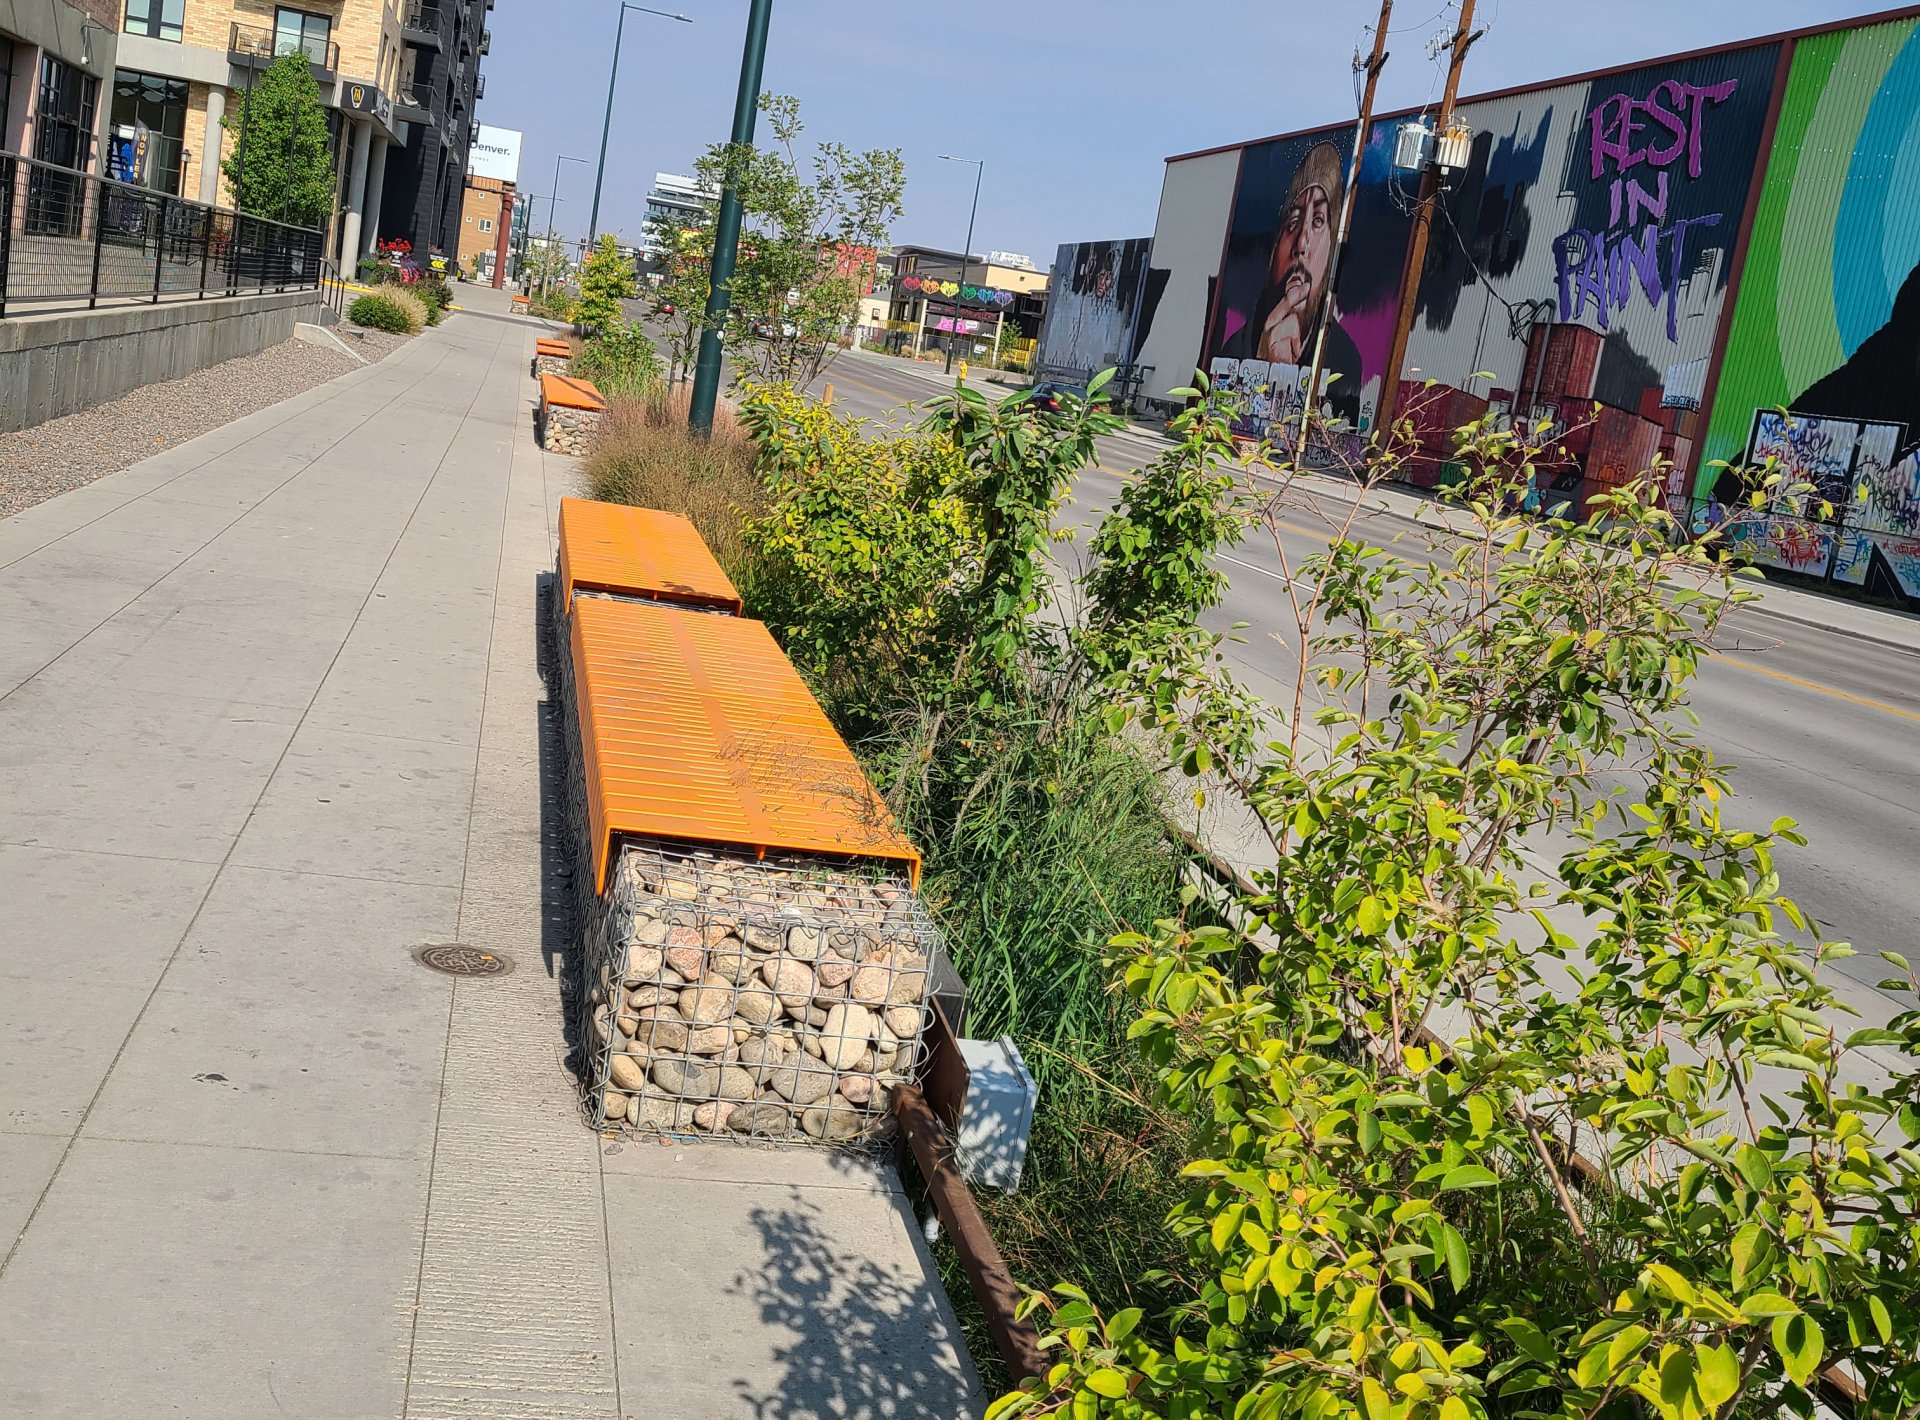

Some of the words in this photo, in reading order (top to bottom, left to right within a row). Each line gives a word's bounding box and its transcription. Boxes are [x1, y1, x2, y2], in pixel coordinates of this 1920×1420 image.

[137, 135, 147, 155] NOW
[1587, 79, 1738, 180] REST
[1609, 171, 1668, 228] IN
